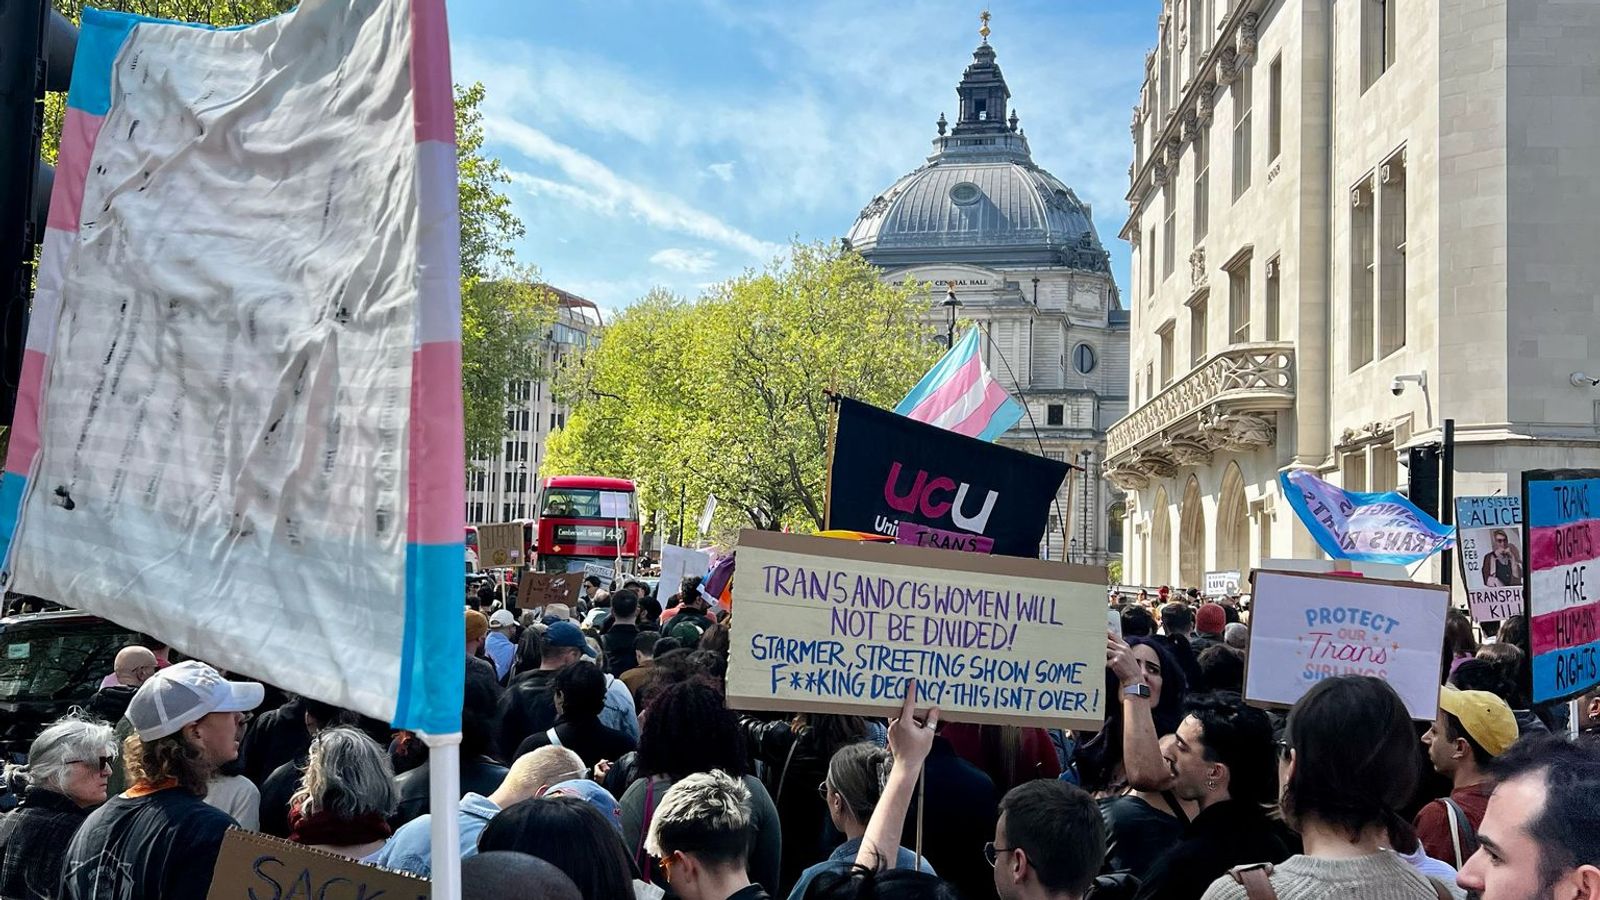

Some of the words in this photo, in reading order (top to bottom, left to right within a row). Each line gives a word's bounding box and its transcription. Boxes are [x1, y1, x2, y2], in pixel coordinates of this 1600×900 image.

[1470, 508, 1522, 526] ALICE
[1472, 498, 1484, 507] MY
[1488, 497, 1519, 508] SISTER
[1553, 483, 1590, 519] TRANS
[915, 530, 978, 552] TRANS
[1464, 539, 1475, 550] 23
[1555, 524, 1592, 561] RIGHTS
[762, 566, 848, 604] TRANS
[851, 575, 895, 609] AND
[897, 581, 931, 610] CIS
[935, 585, 1010, 620] WOMEN
[1016, 593, 1063, 626] WILL
[1470, 590, 1520, 604] TRANSPH
[1564, 565, 1587, 604] ARE
[831, 606, 880, 640] NOT
[888, 613, 916, 642] BE
[923, 616, 1017, 651] DIVIDED!
[1305, 607, 1400, 634] PROTECT
[1337, 628, 1366, 640] OUR
[1556, 608, 1596, 645] HUMAN
[855, 644, 965, 678] STREETING
[970, 655, 1030, 684] SHOW
[1035, 660, 1087, 684] SOME
[1308, 632, 1387, 665] Trans
[1556, 647, 1597, 690] RIGHTS
